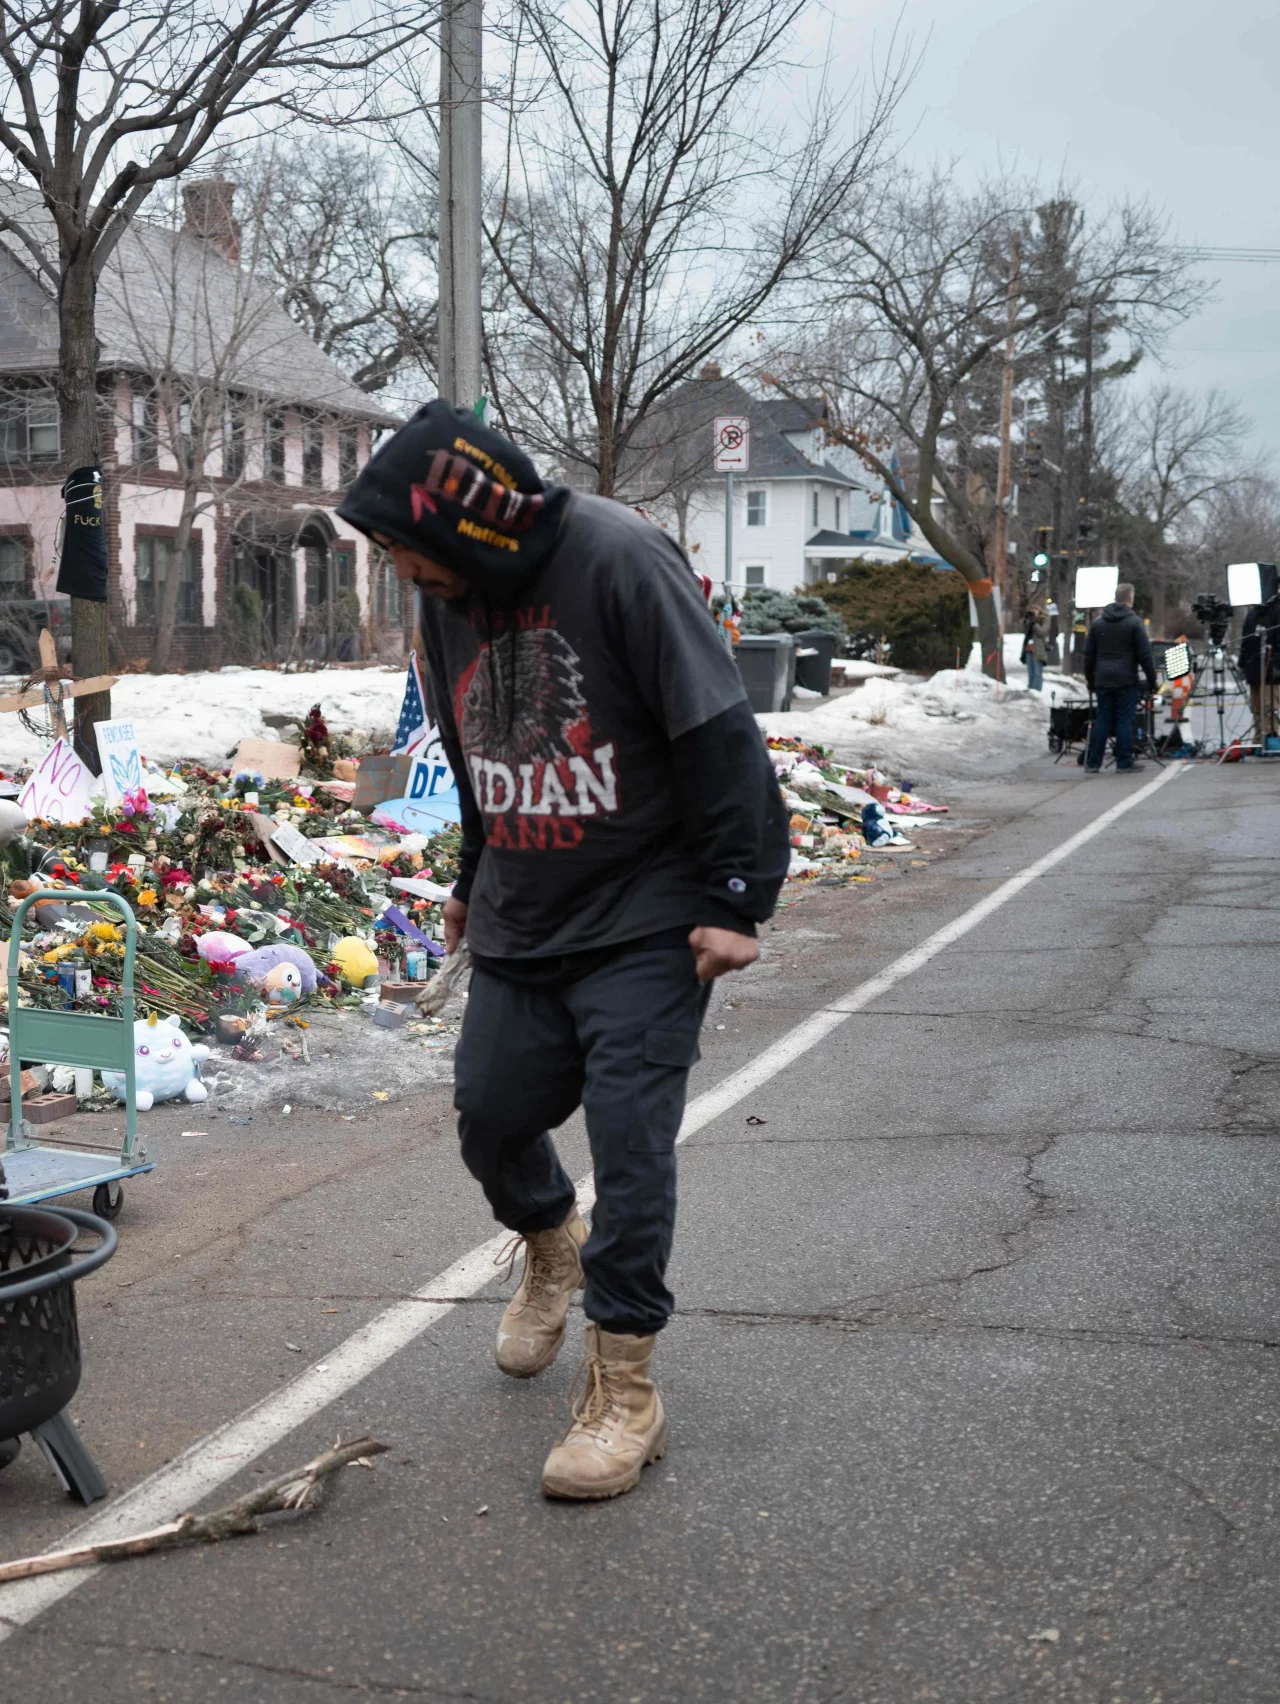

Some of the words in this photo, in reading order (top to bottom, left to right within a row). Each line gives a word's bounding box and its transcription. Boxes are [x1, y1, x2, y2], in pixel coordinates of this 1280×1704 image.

[454, 437, 494, 469] Every
[74, 514, 101, 527] FUCK
[457, 518, 520, 552] Matters
[38, 739, 82, 797] NO
